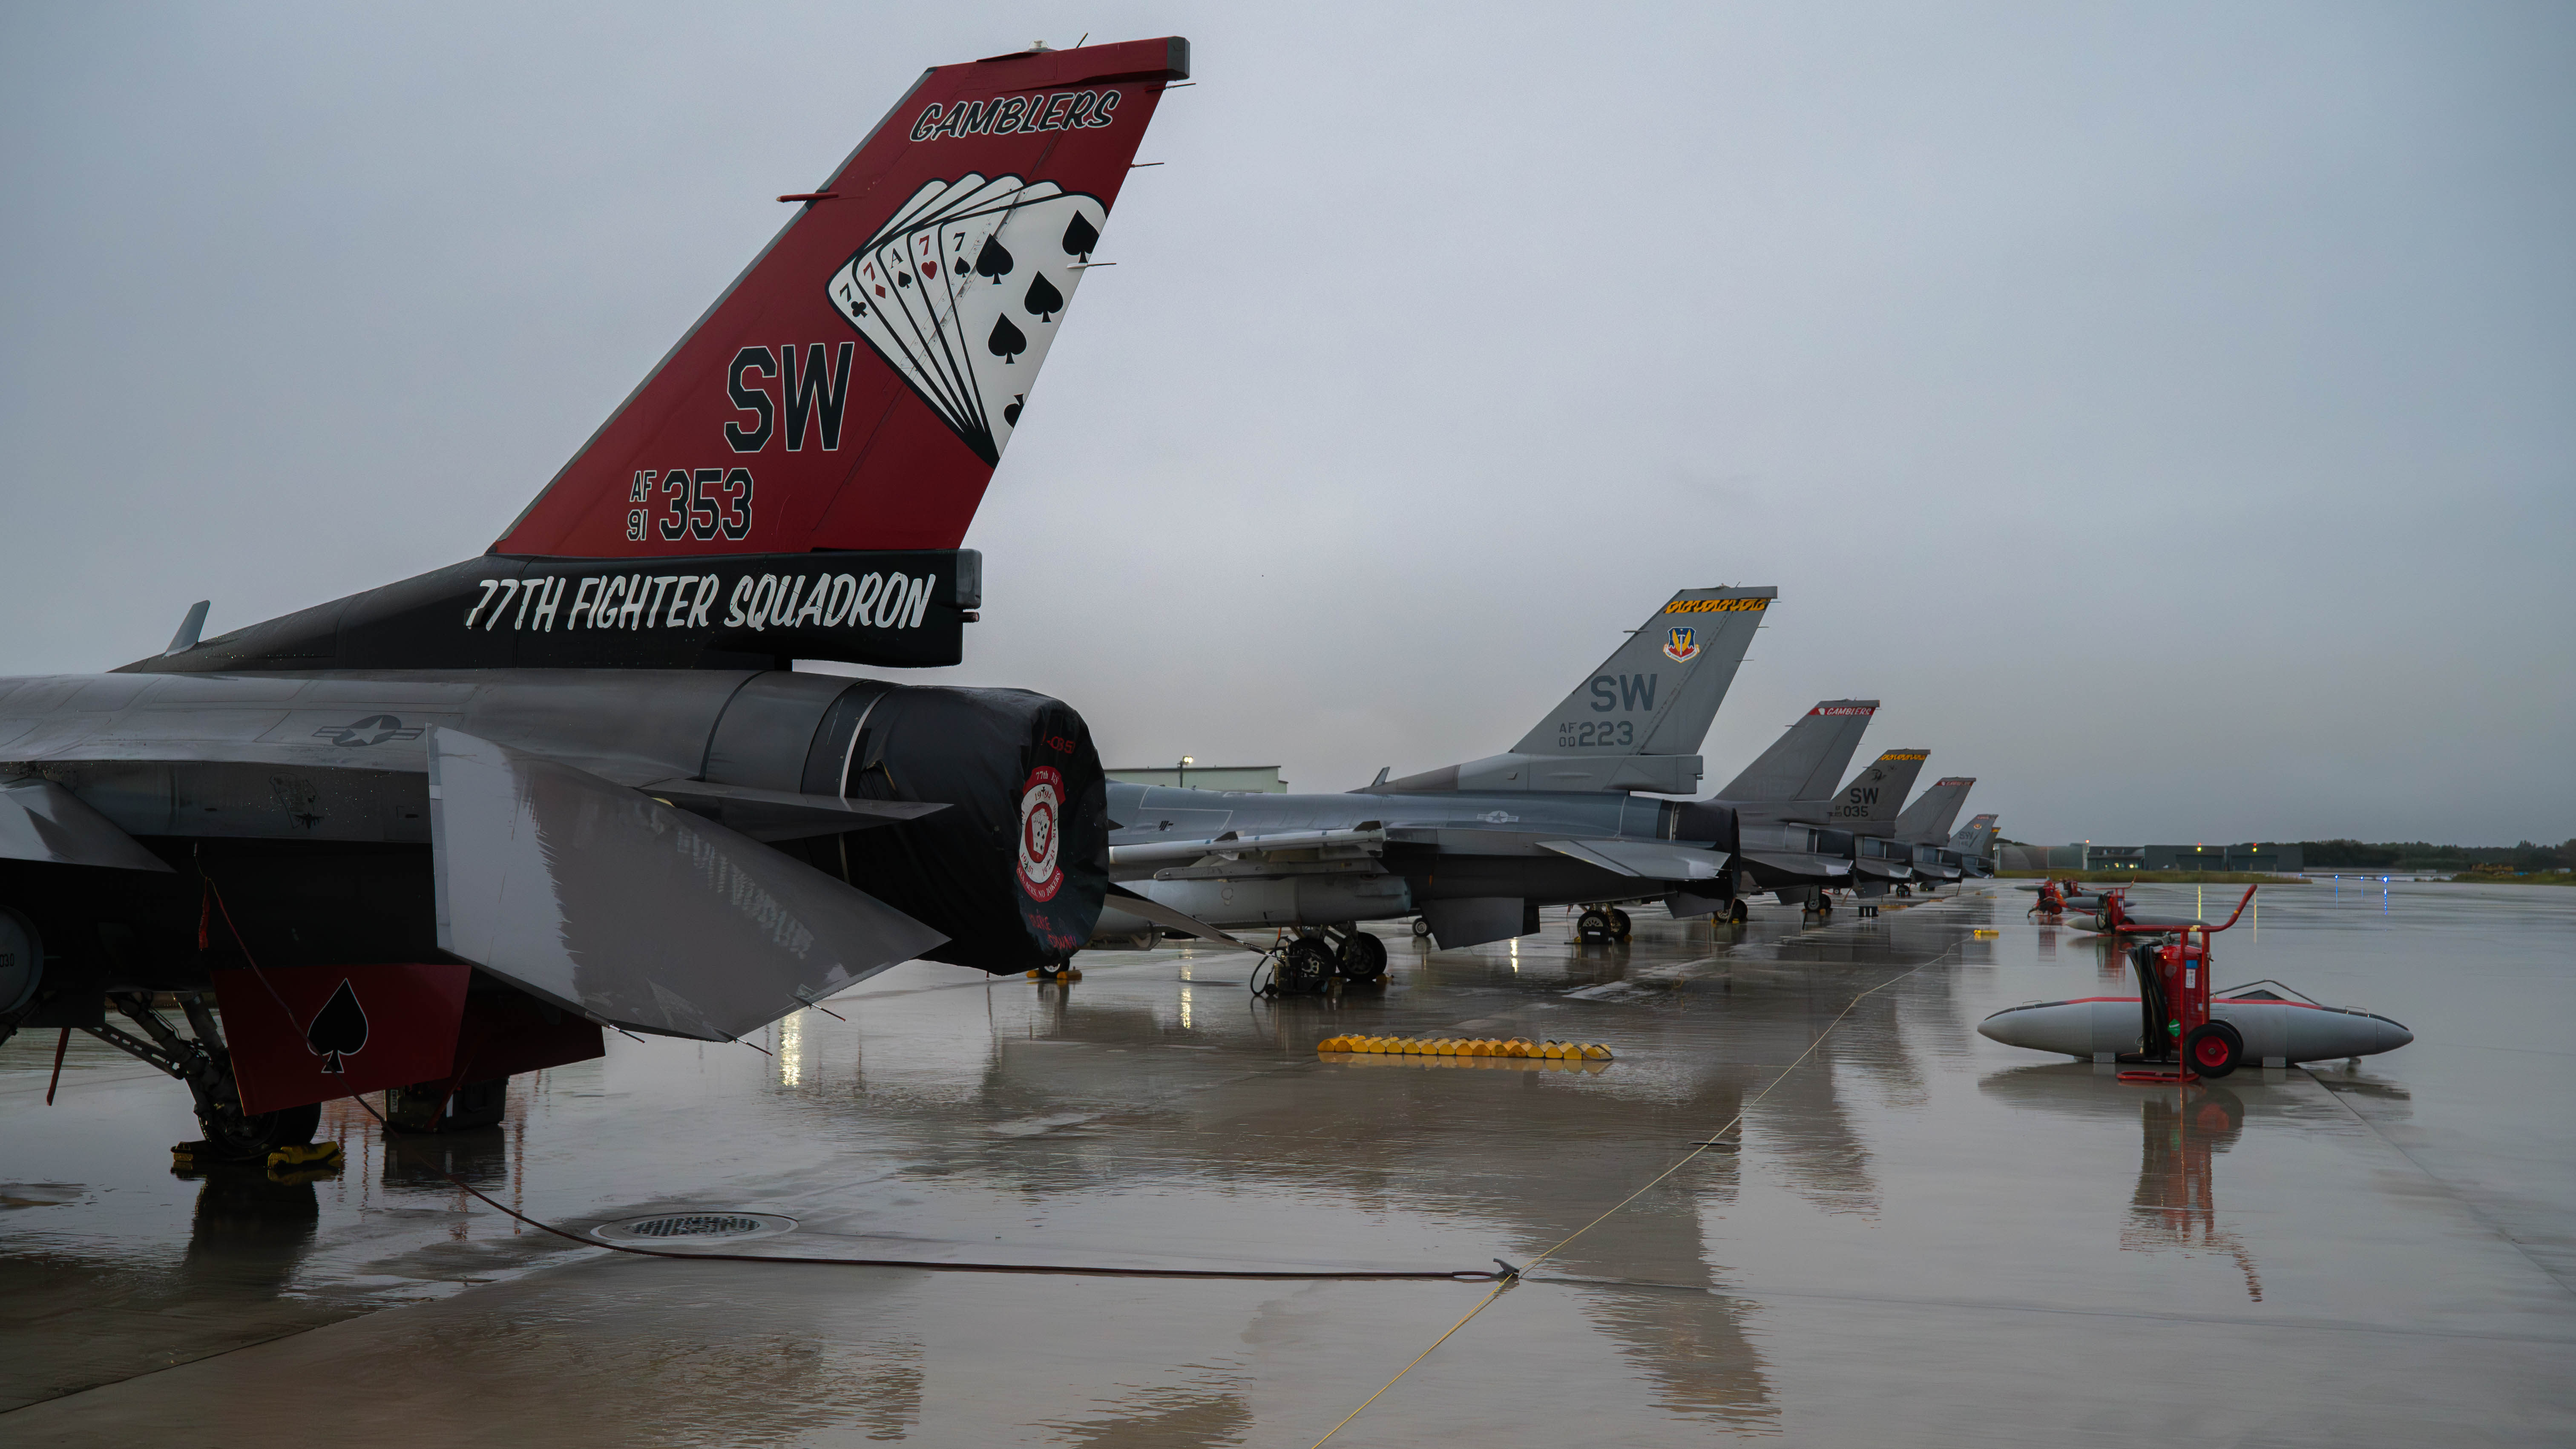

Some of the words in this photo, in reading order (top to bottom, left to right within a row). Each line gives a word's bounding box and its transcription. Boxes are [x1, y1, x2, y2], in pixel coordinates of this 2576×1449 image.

[910, 89, 1121, 141] GAMBLERS
[839, 282, 852, 302] 7
[863, 262, 876, 282] 7
[890, 248, 904, 269] A
[919, 235, 930, 256] 7
[953, 232, 966, 252] 7
[724, 342, 855, 453] SW
[630, 470, 657, 502] AF
[659, 467, 753, 540] 353
[627, 509, 648, 540] 91
[467, 576, 566, 632] 77TH
[567, 573, 719, 630] FIGHTER
[724, 572, 936, 631] SQUADRON
[1590, 673, 1658, 713] SW
[1559, 722, 1577, 733] AF
[1559, 736, 1576, 747] 00
[1578, 721, 1633, 747] 223
[1036, 770, 1048, 780] 77th
[1843, 805, 1869, 817] 035
[1850, 788, 1878, 804] SW
[1046, 871, 1061, 896] JOKERS
